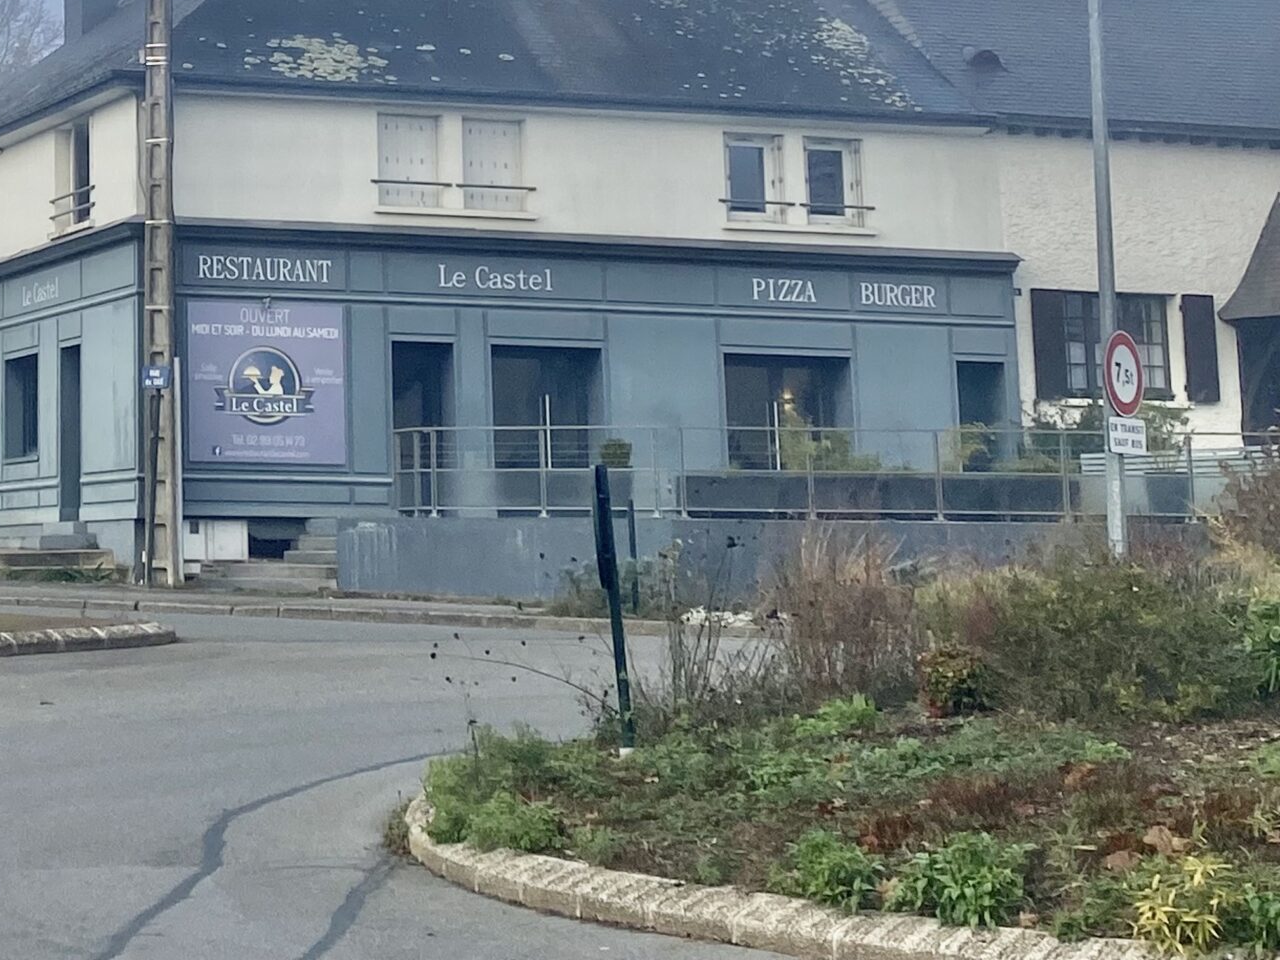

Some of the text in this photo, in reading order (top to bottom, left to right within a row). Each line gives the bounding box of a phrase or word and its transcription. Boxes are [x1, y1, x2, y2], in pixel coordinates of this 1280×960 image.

[199, 255, 331, 283] RESTAURANT
[439, 264, 553, 292] Le Castel
[22, 277, 59, 307] Le Castel
[752, 277, 816, 304] PIZZA
[859, 281, 936, 309] BURGER
[240, 307, 290, 323] OUVERT
[192, 324, 209, 335] MIDI
[211, 324, 222, 335] ET
[224, 324, 244, 336] SOIR
[252, 326, 264, 337] DU
[266, 326, 292, 337] LUNDI
[293, 327, 304, 338] AU
[306, 327, 339, 339] SAMEDI
[232, 397, 298, 413] Le Castel
